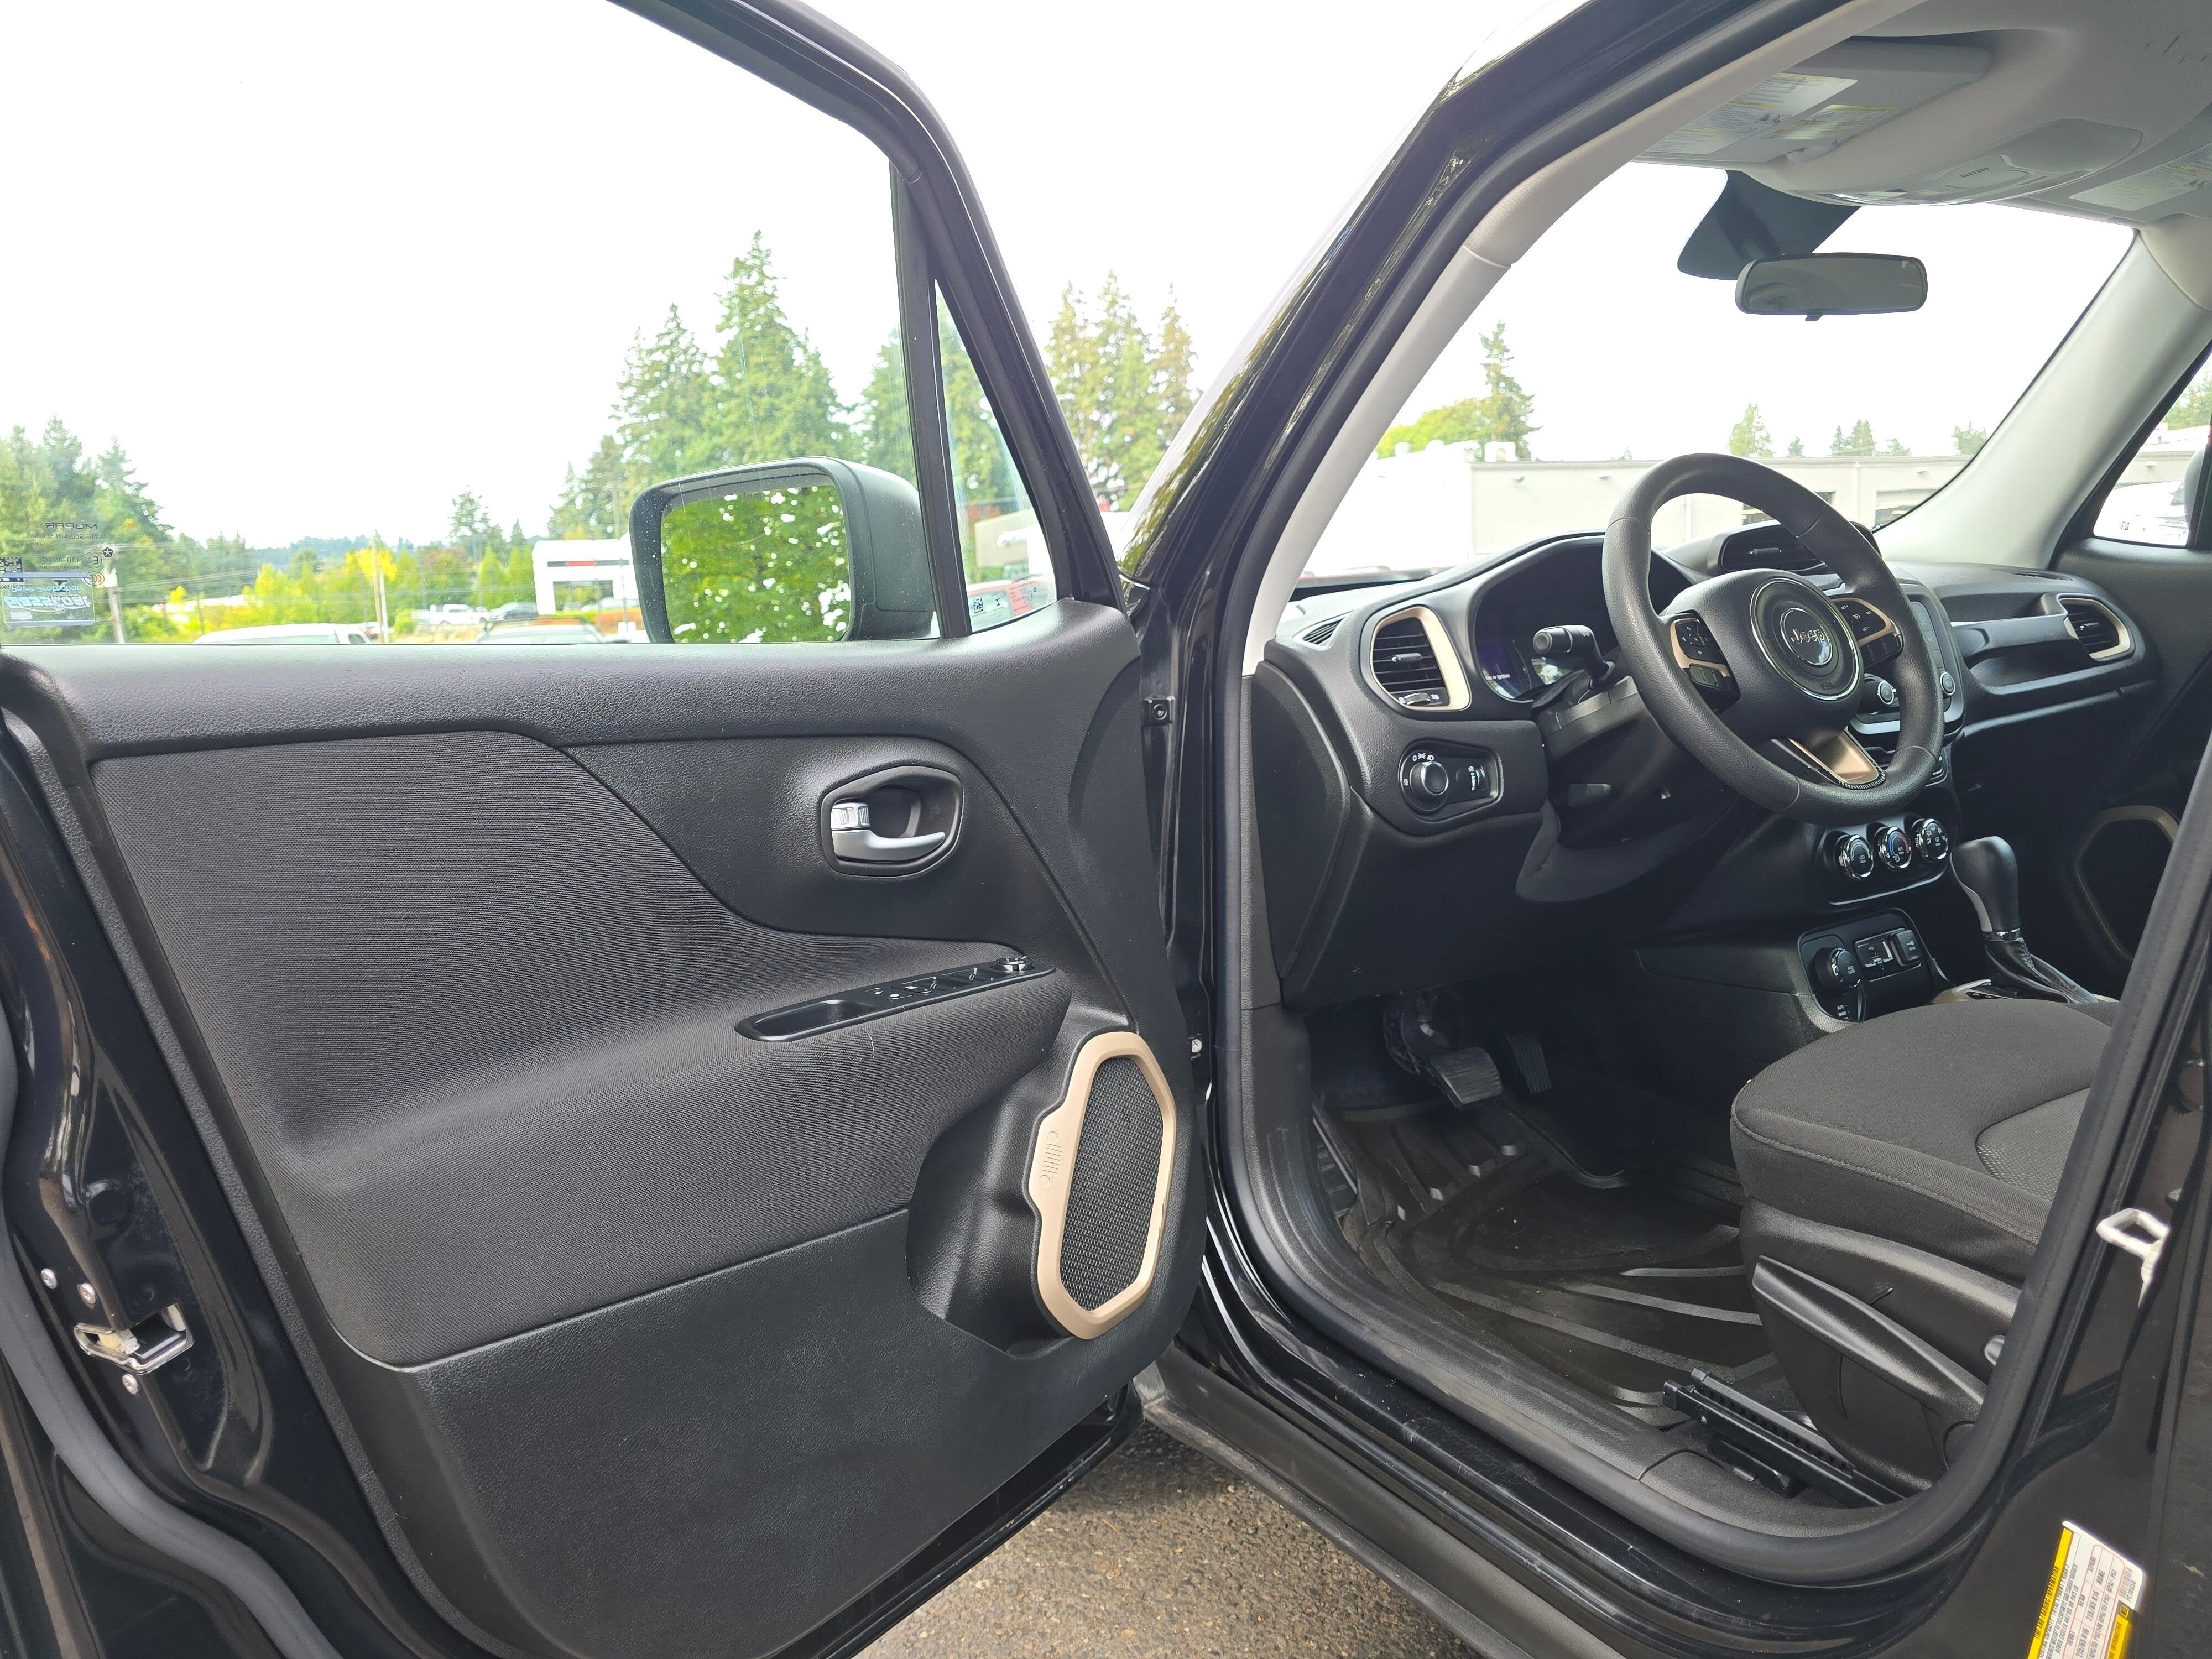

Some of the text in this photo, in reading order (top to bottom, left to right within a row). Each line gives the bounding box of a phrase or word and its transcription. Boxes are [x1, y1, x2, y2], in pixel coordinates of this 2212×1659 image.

[1791, 628, 1825, 644] Jeep
[2075, 1639, 2086, 1658] 215/65
[2086, 1601, 2096, 1621] 215/65
[2096, 1569, 2105, 1585] NONE
